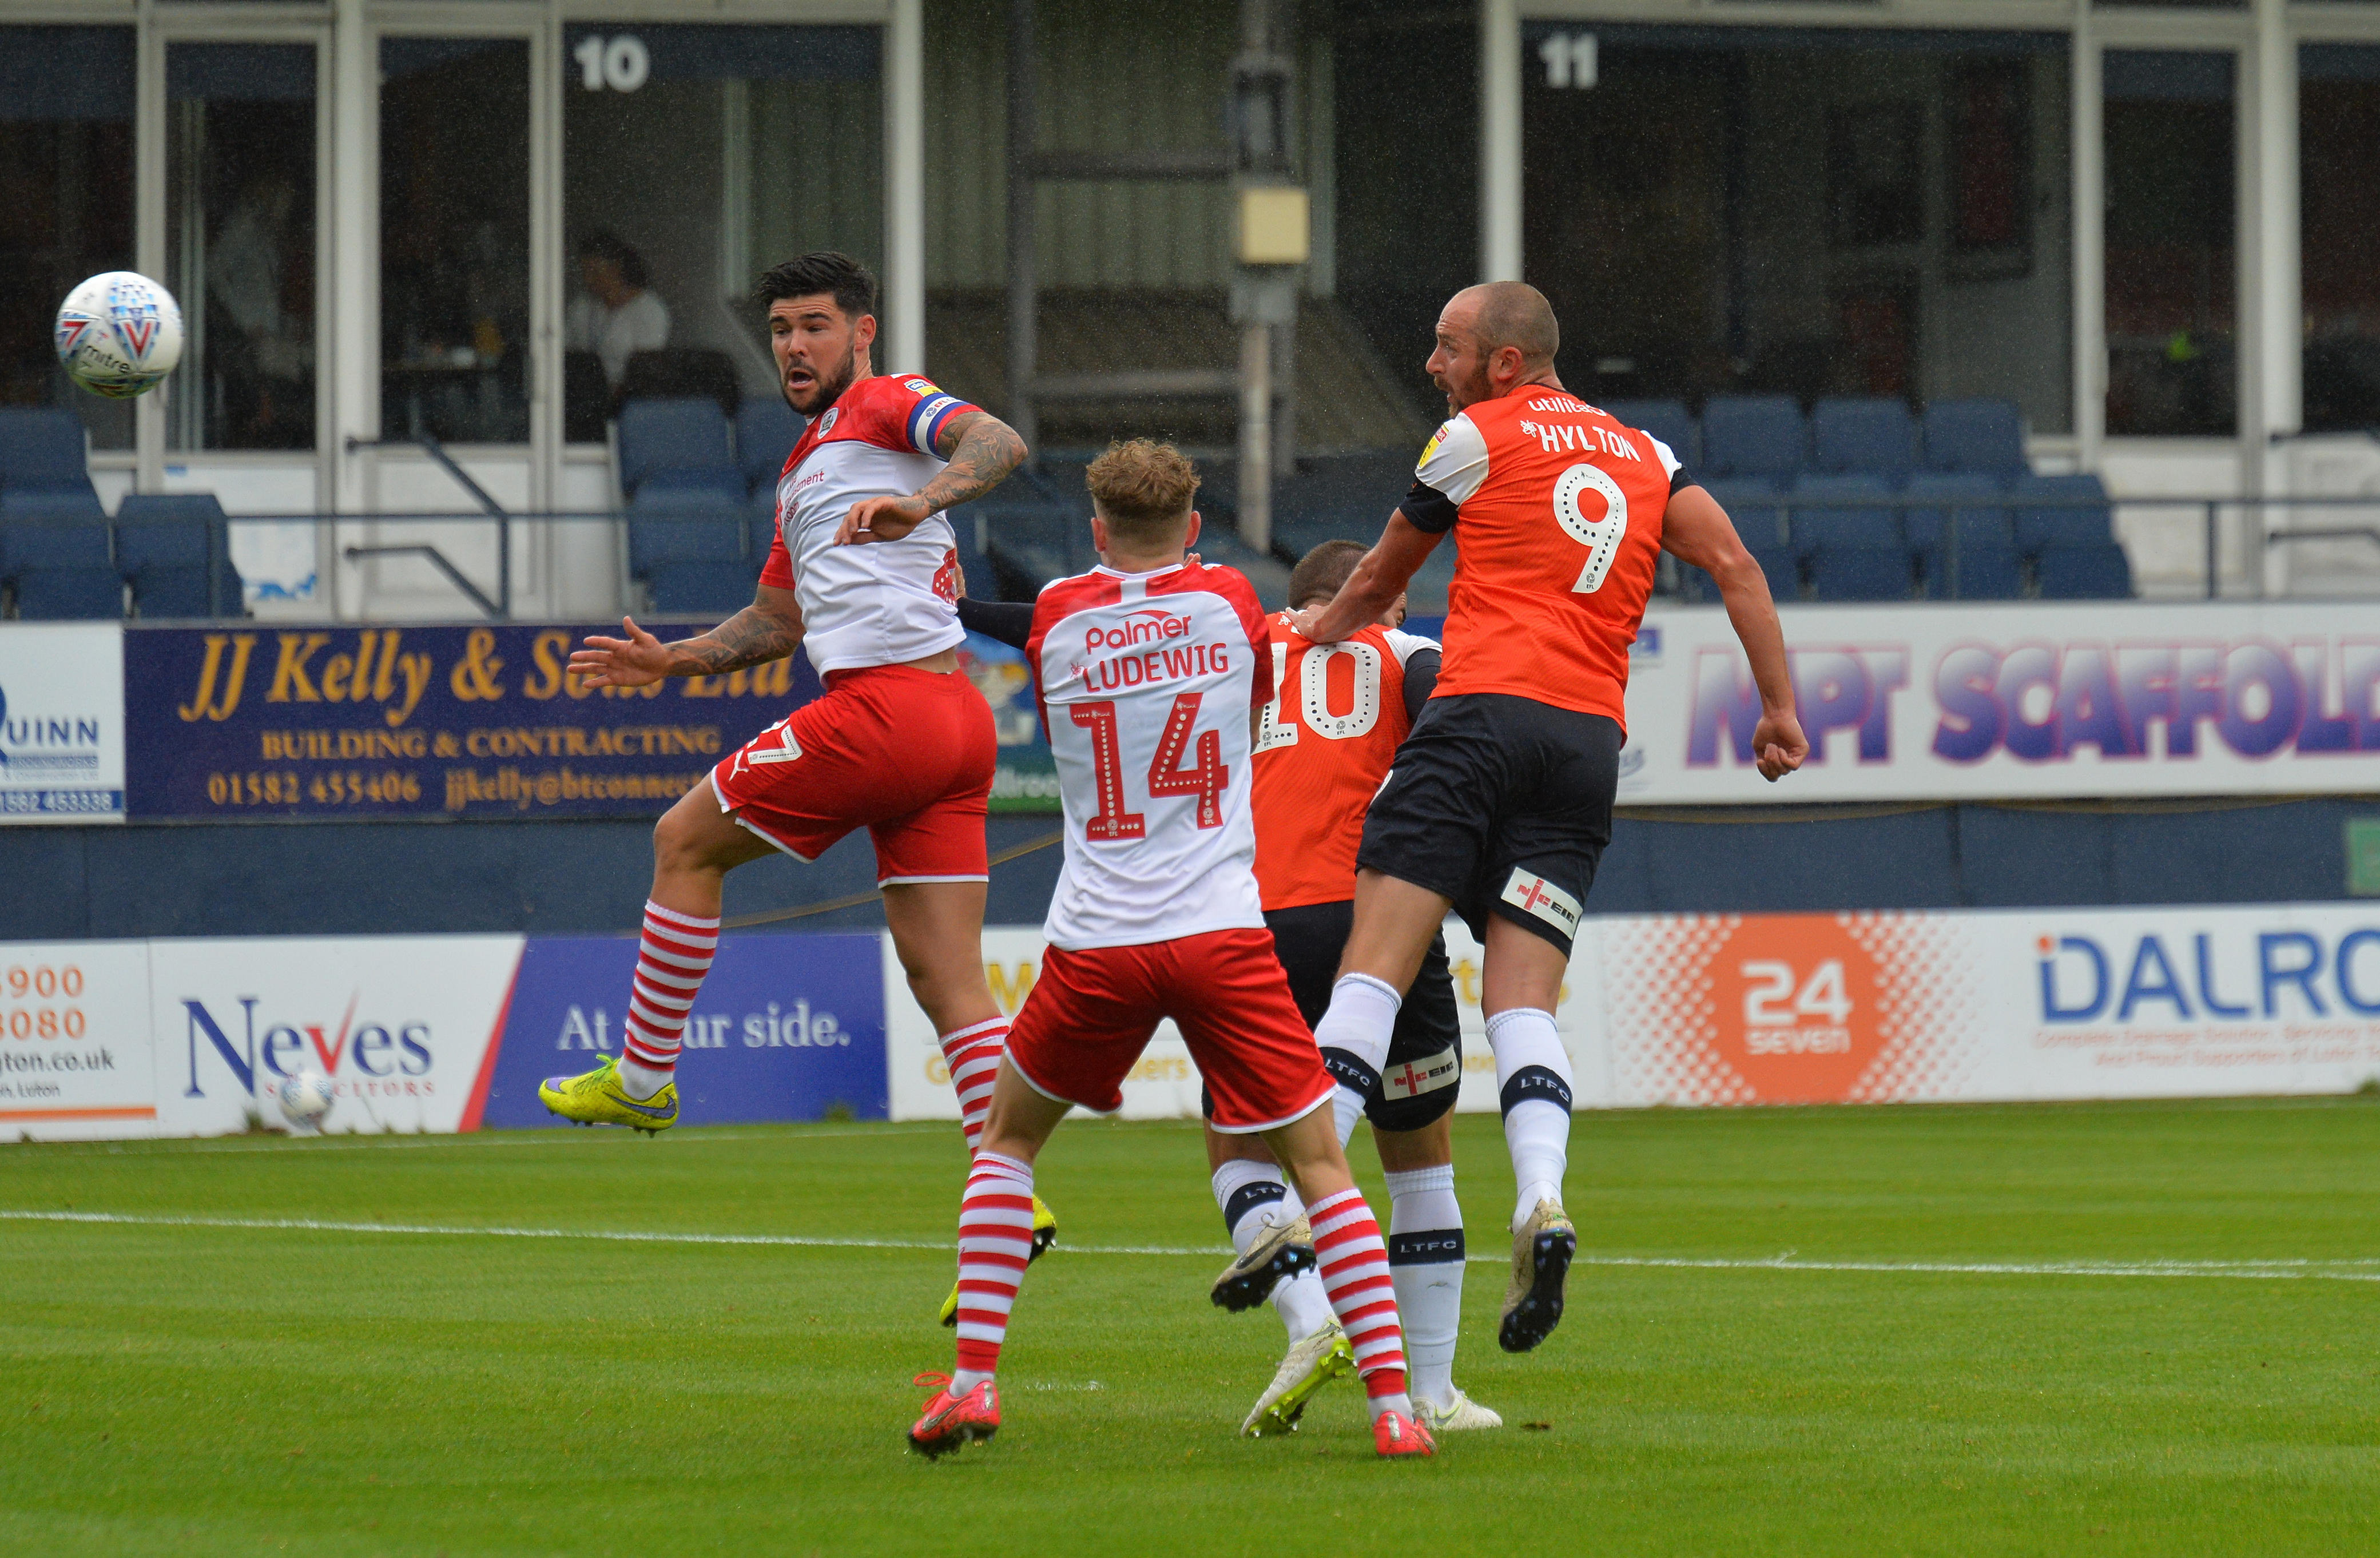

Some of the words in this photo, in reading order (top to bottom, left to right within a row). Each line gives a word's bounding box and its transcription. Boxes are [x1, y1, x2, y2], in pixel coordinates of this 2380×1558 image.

[574, 33, 650, 93] 10
[1538, 33, 1599, 89] 11
[84, 345, 130, 373] mitre
[1536, 424, 1641, 462] HYLTON
[1553, 464, 1627, 593] 9
[1086, 614, 1192, 654] palmer
[178, 633, 257, 722] JJ
[265, 629, 433, 727] Kelly
[450, 629, 504, 701] &
[1083, 643, 1229, 693] LUDEWIG
[0, 717, 98, 747] UINN
[263, 729, 427, 760] BUILDING
[434, 729, 457, 758] &
[467, 725, 720, 756] CONTRACTING
[1069, 692, 1229, 841] 14
[208, 772, 300, 805] 01582
[309, 772, 422, 803] 455406
[1739, 959, 1853, 1027] 24
[181, 987, 434, 1098] Neves
[557, 1004, 613, 1050] At
[745, 998, 851, 1048] side.
[0, 1045, 115, 1074] ton.co.uk
[1325, 1058, 1370, 1087] LTFC
[17, 1082, 61, 1098] Luton
[1521, 1076, 1569, 1102] LTFC
[1401, 1241, 1456, 1253] LTFC
